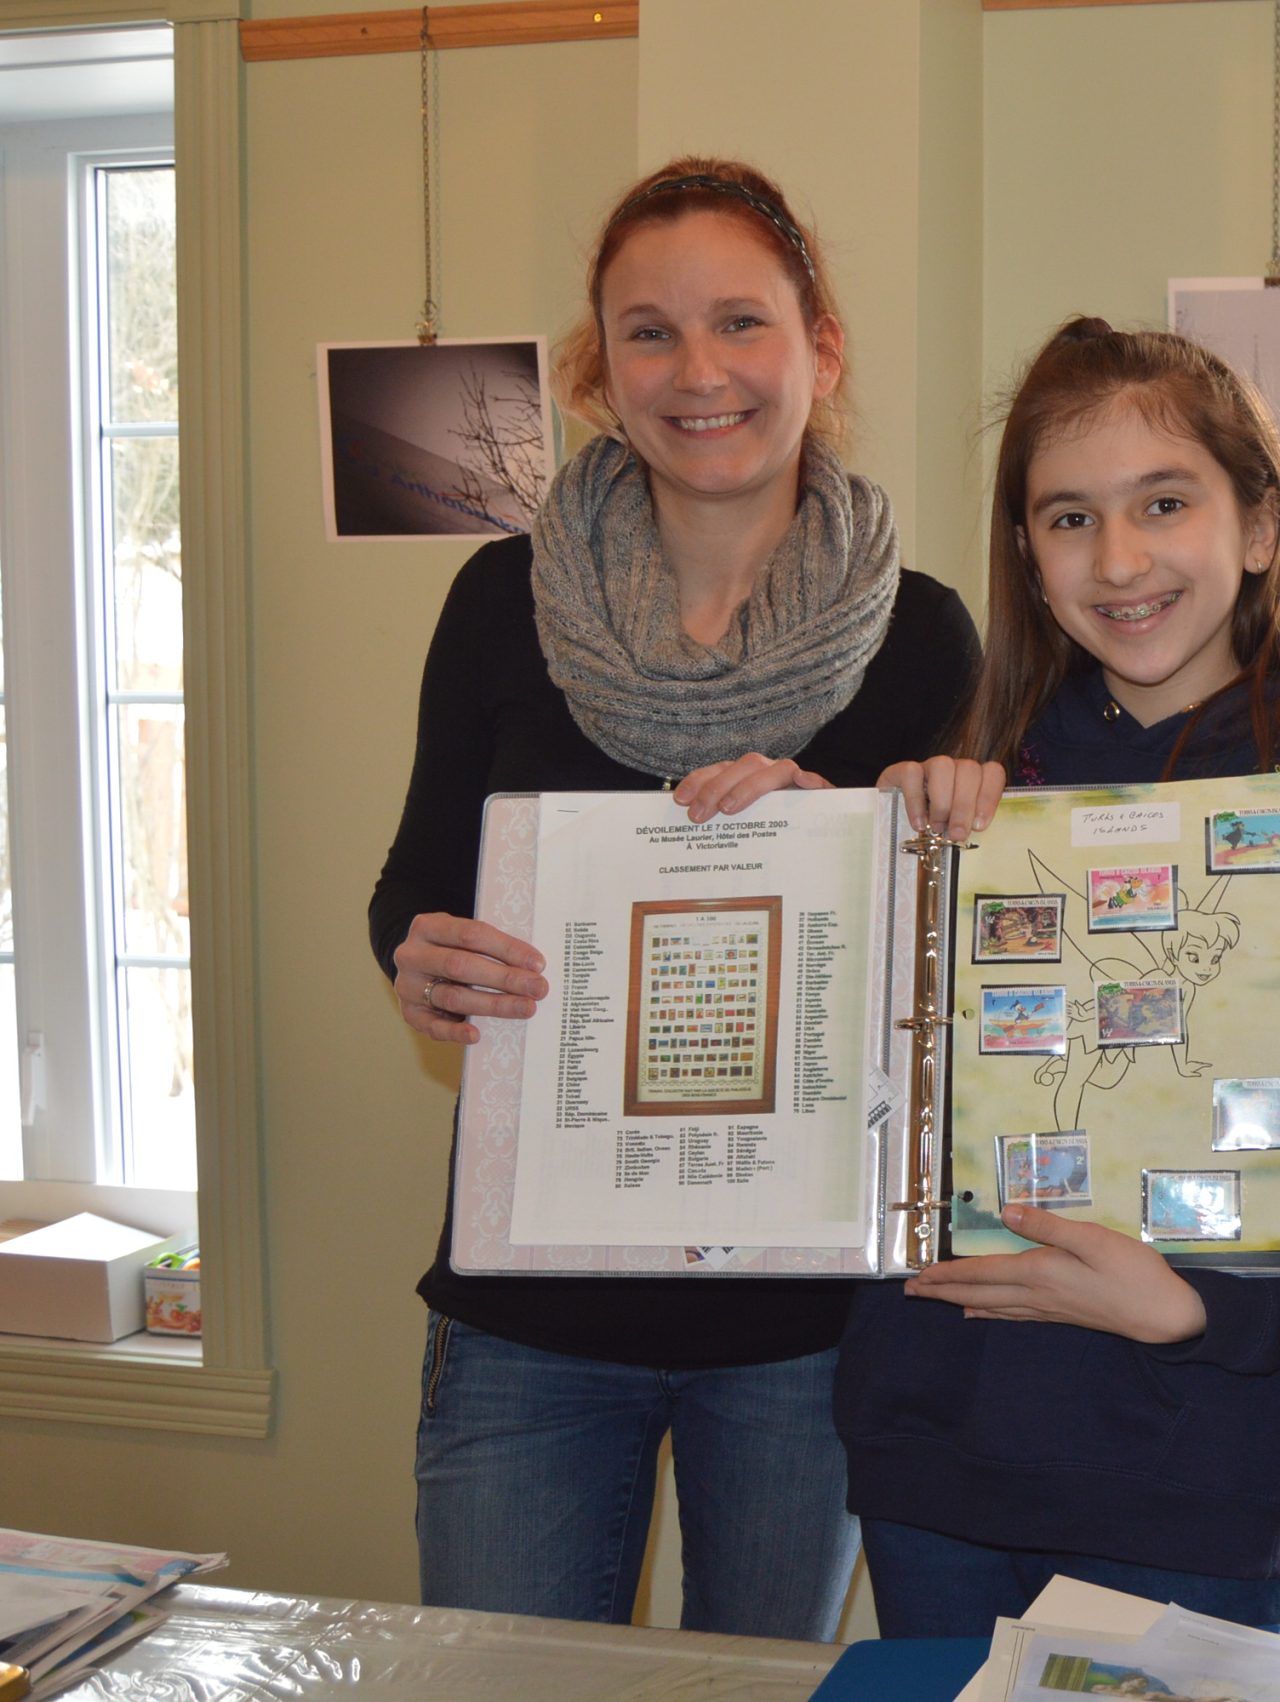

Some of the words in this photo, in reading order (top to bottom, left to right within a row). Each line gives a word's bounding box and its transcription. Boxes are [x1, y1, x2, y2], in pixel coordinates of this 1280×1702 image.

[636, 826, 699, 835] DÉVOILEMENT
[722, 822, 766, 831] OCTOBRE
[768, 820, 788, 828] 2003
[686, 833, 714, 842] Laurier,
[716, 831, 735, 839] Hôtel
[696, 841, 738, 849] Victoriaville
[659, 864, 711, 874] CLASSEMENT
[713, 863, 729, 871] PAR
[731, 862, 763, 870] VALEUR
